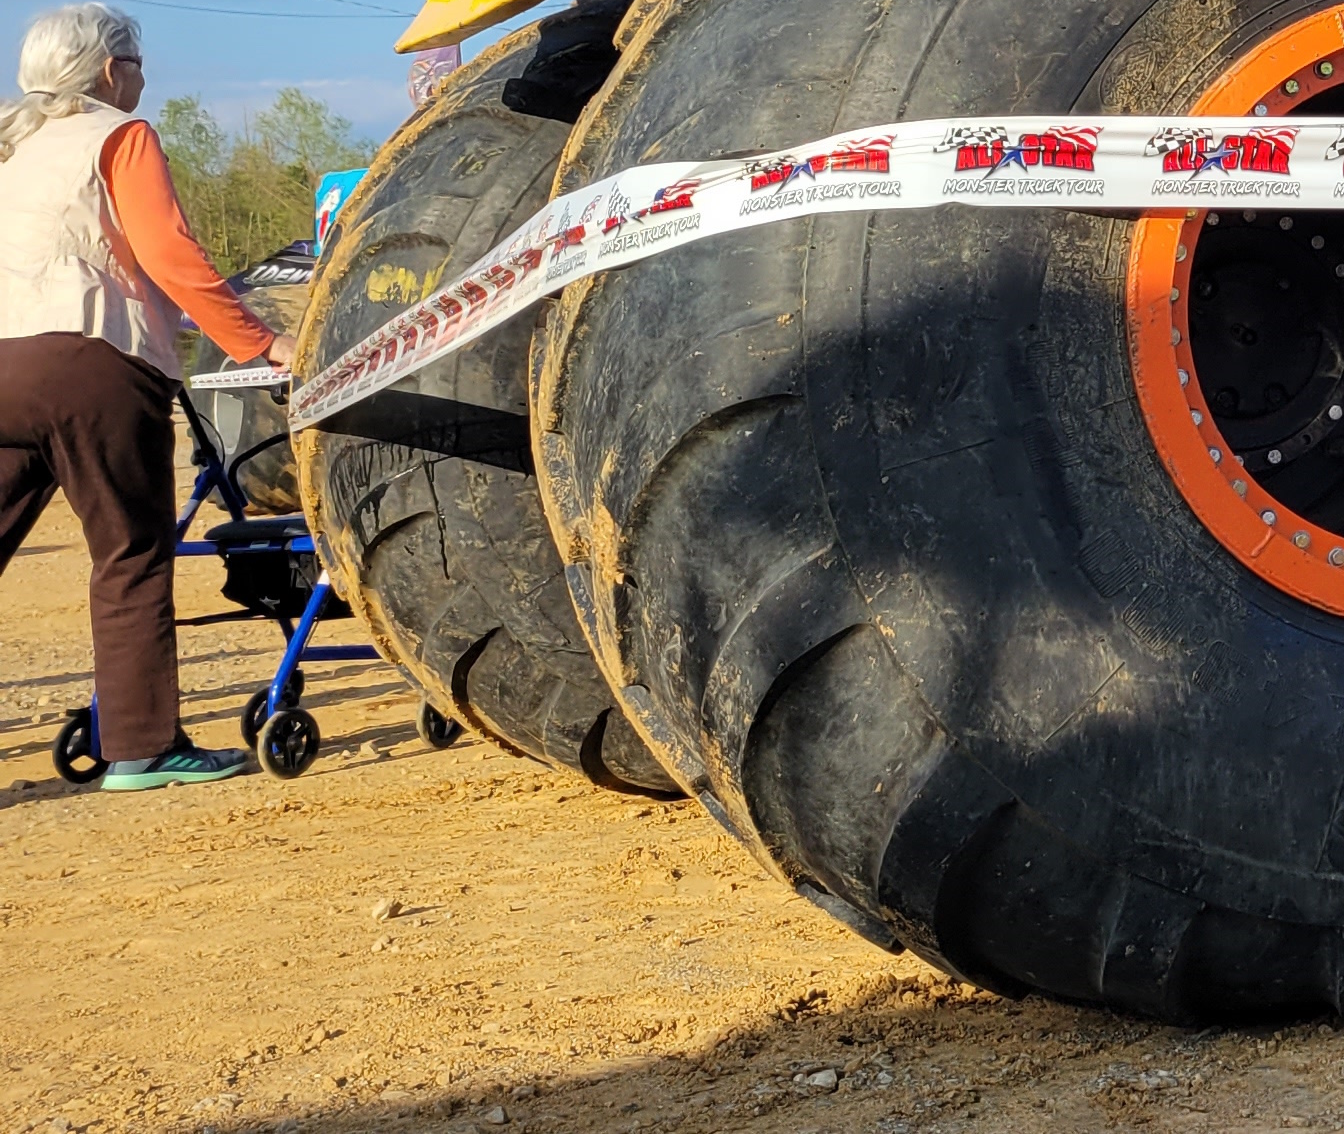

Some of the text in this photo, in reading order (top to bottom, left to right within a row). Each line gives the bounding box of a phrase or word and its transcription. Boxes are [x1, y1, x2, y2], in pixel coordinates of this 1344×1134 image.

[1220, 136, 1290, 175] STAR
[739, 180, 902, 217] MONSTER TRUCK TOUR
[1152, 180, 1300, 197] MONSTER TRUCK TOUR
